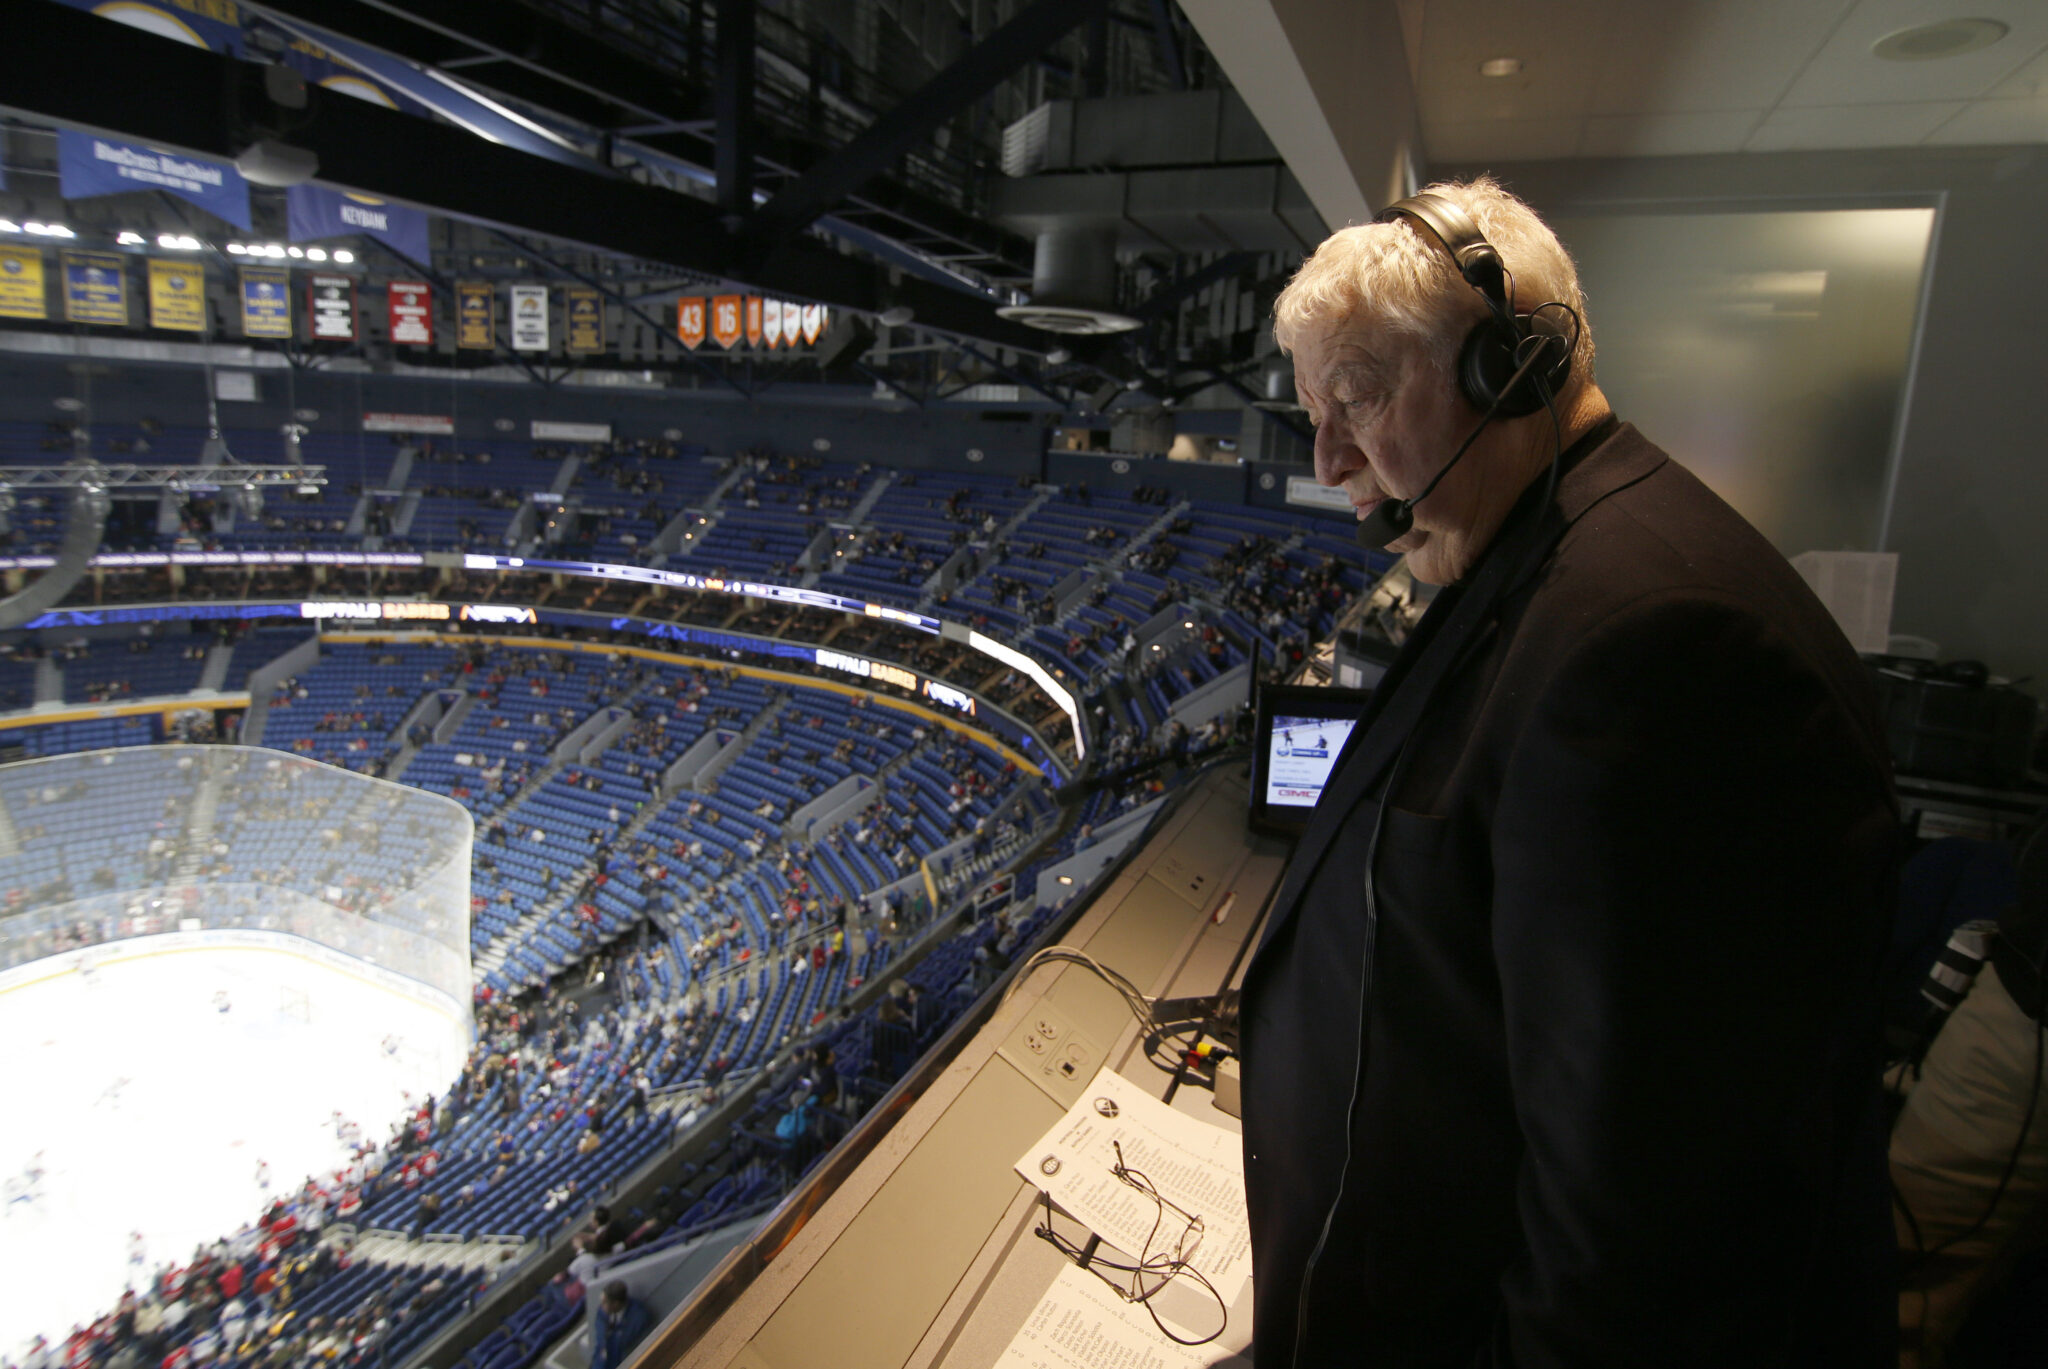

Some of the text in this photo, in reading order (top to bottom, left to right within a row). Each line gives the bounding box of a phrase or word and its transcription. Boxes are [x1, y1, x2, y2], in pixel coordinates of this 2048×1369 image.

[340, 205, 388, 231] KEYBANK
[680, 304, 702, 335] 43
[717, 303, 736, 334] 16
[301, 602, 381, 618] BUFFALO
[382, 603, 450, 620] SABRES
[815, 648, 918, 691] BUFFALO SABRES
